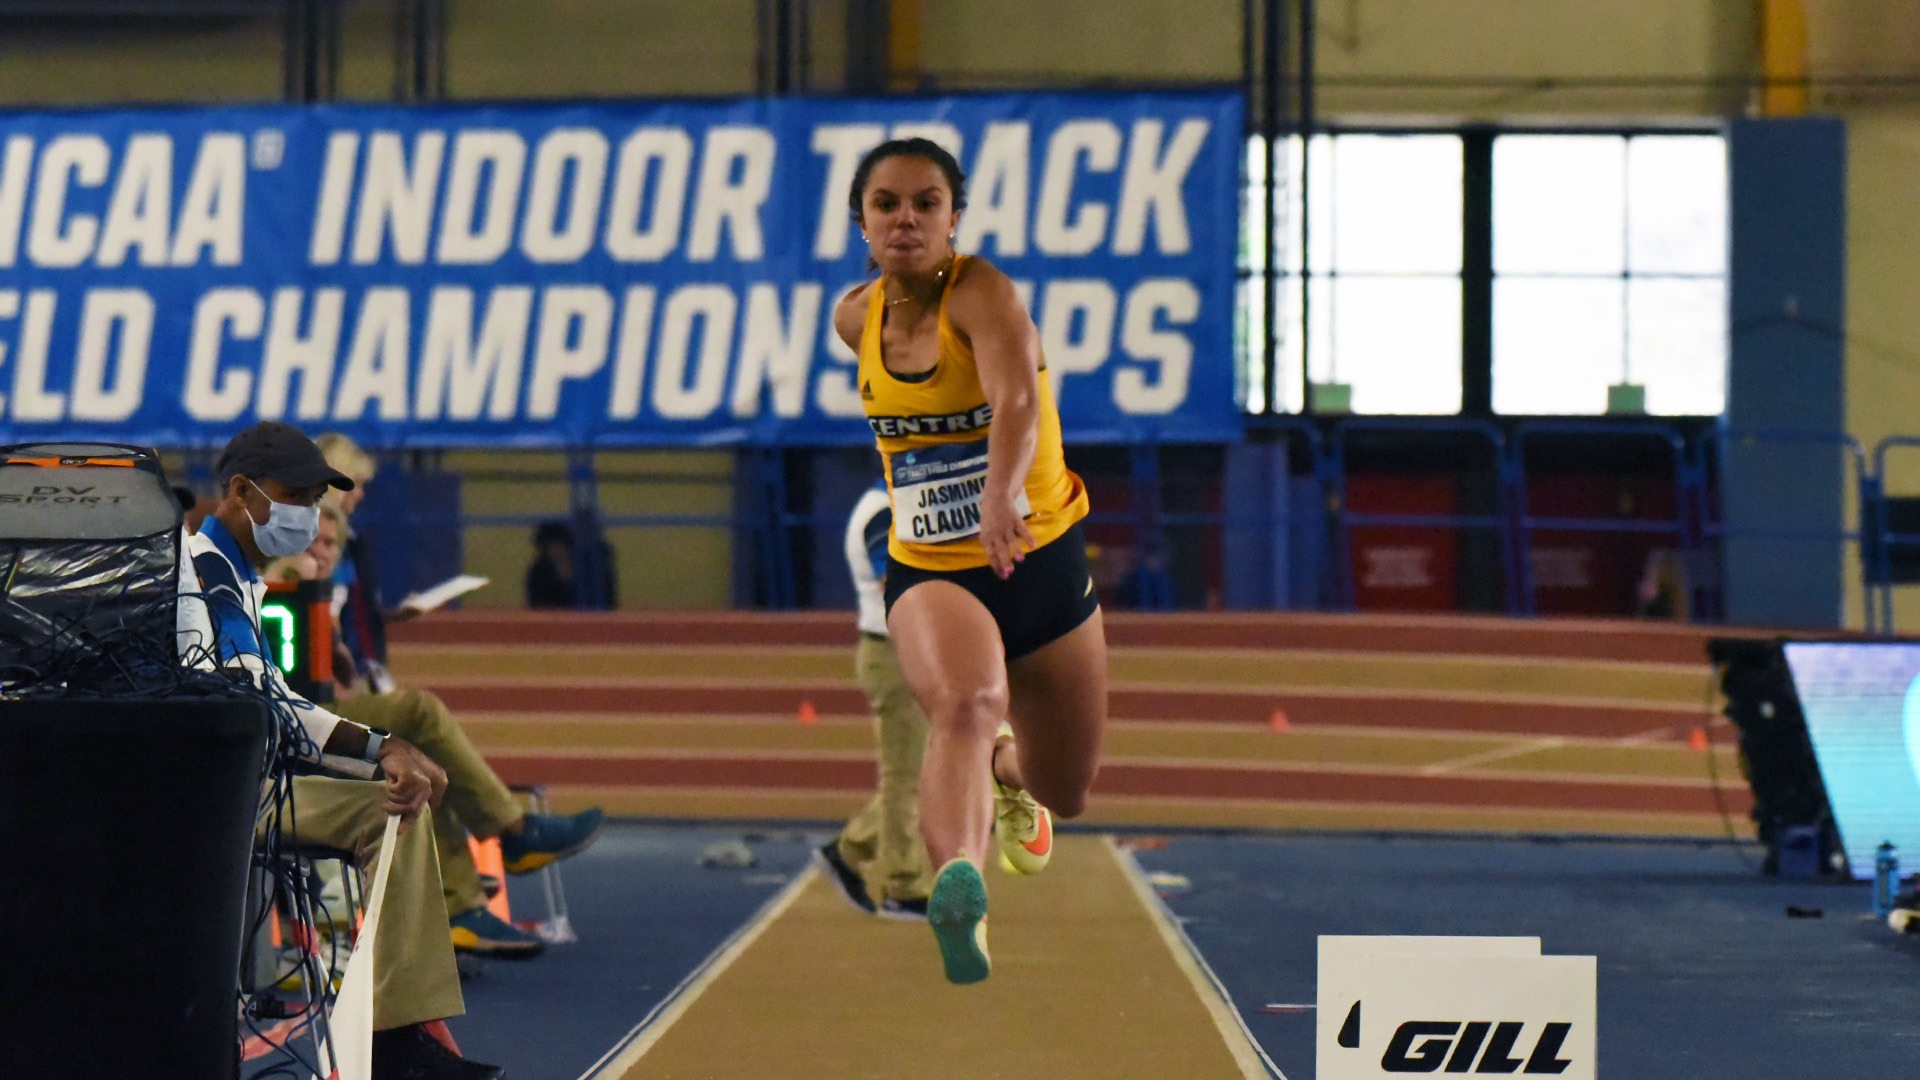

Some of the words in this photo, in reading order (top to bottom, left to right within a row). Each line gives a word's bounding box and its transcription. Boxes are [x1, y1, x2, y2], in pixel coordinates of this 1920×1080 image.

[309, 127, 776, 265] INDOOR
[182, 278, 1200, 423] CHAMPIONPS
[869, 404, 993, 437] CENTRE
[0, 494, 128, 505] SPORT
[32, 486, 95, 496] DV
[1381, 1020, 1573, 1074] GILL
